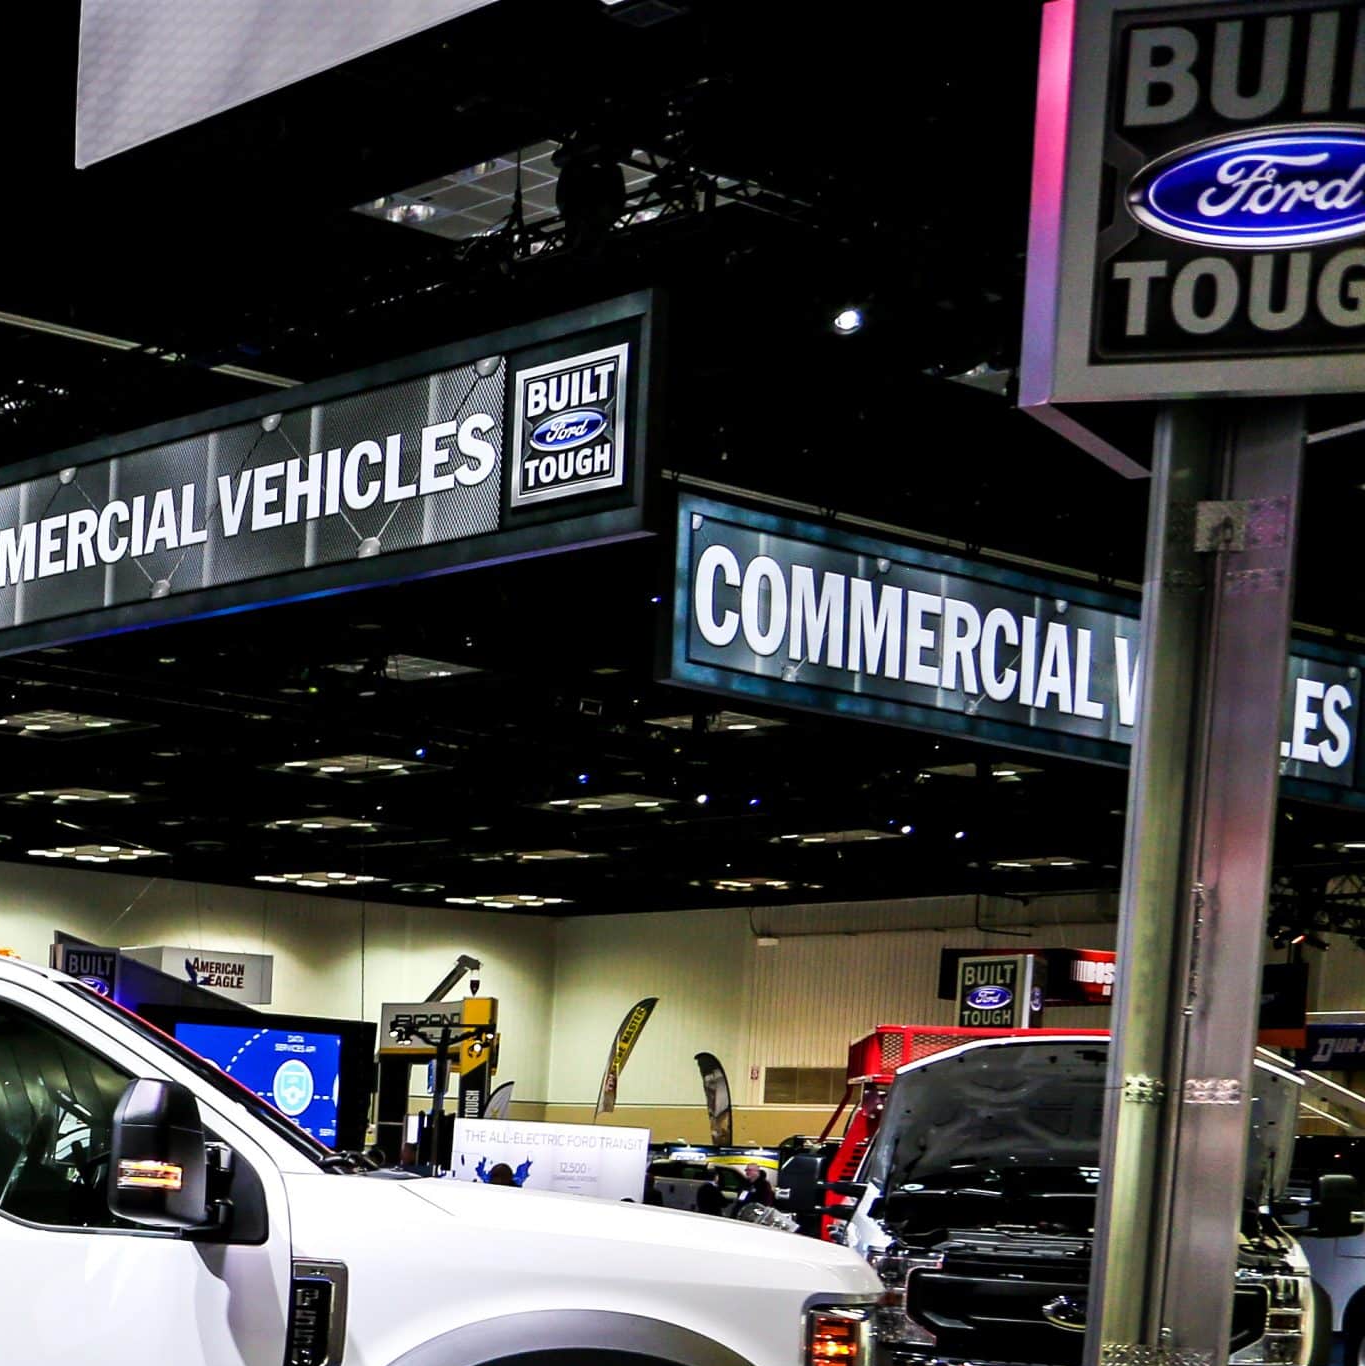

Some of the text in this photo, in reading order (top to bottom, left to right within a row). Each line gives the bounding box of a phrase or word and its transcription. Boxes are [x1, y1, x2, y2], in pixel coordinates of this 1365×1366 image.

[1123, 11, 1365, 127] BUI
[1196, 152, 1364, 218] Ford
[527, 362, 615, 417] BUILT
[545, 416, 589, 443] Ford
[217, 412, 501, 536] VEHICLES
[524, 442, 611, 488] TOUGH
[694, 544, 1104, 720] COMMERCIAL
[69, 954, 114, 977] BUILT
[193, 957, 245, 976] AMERICAN
[965, 964, 1014, 986] BUILT
[1073, 960, 1116, 984] BOS
[208, 974, 244, 989] EAGLE
[975, 990, 1001, 1003] Ford
[962, 1010, 1012, 1026] TOUGH
[465, 1129, 644, 1151] THE ALL-ELECTRIC FORD TRANSIT
